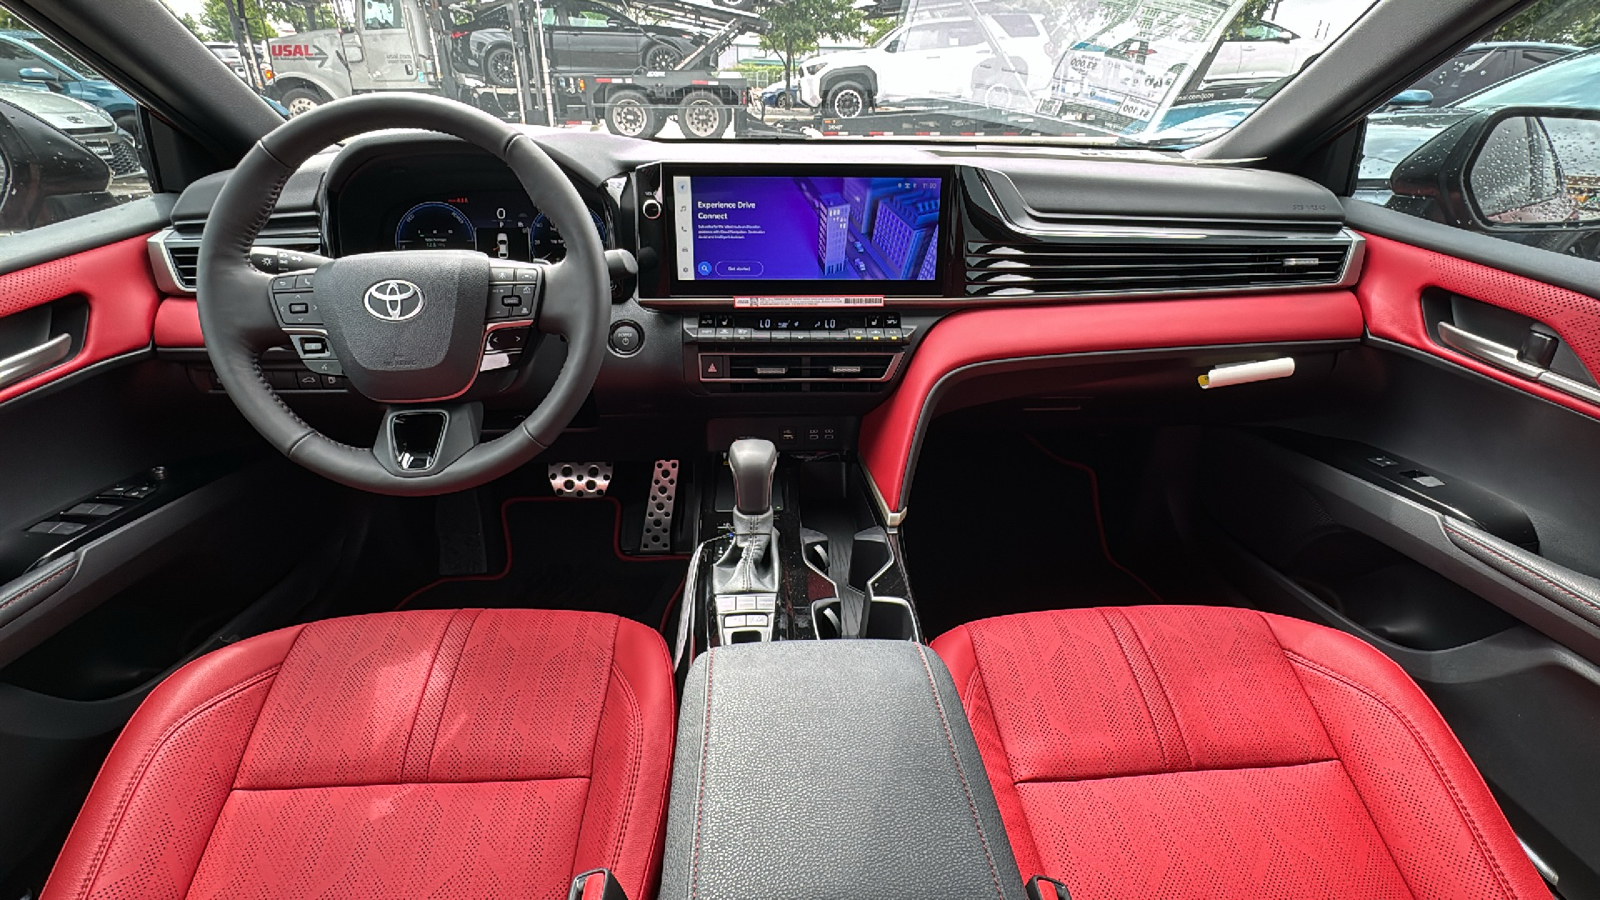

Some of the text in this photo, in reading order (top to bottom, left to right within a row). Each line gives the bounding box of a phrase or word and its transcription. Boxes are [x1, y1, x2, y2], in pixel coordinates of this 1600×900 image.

[271, 44, 313, 57] USAL
[697, 201, 756, 210] Experience Drive
[496, 208, 506, 219] 0
